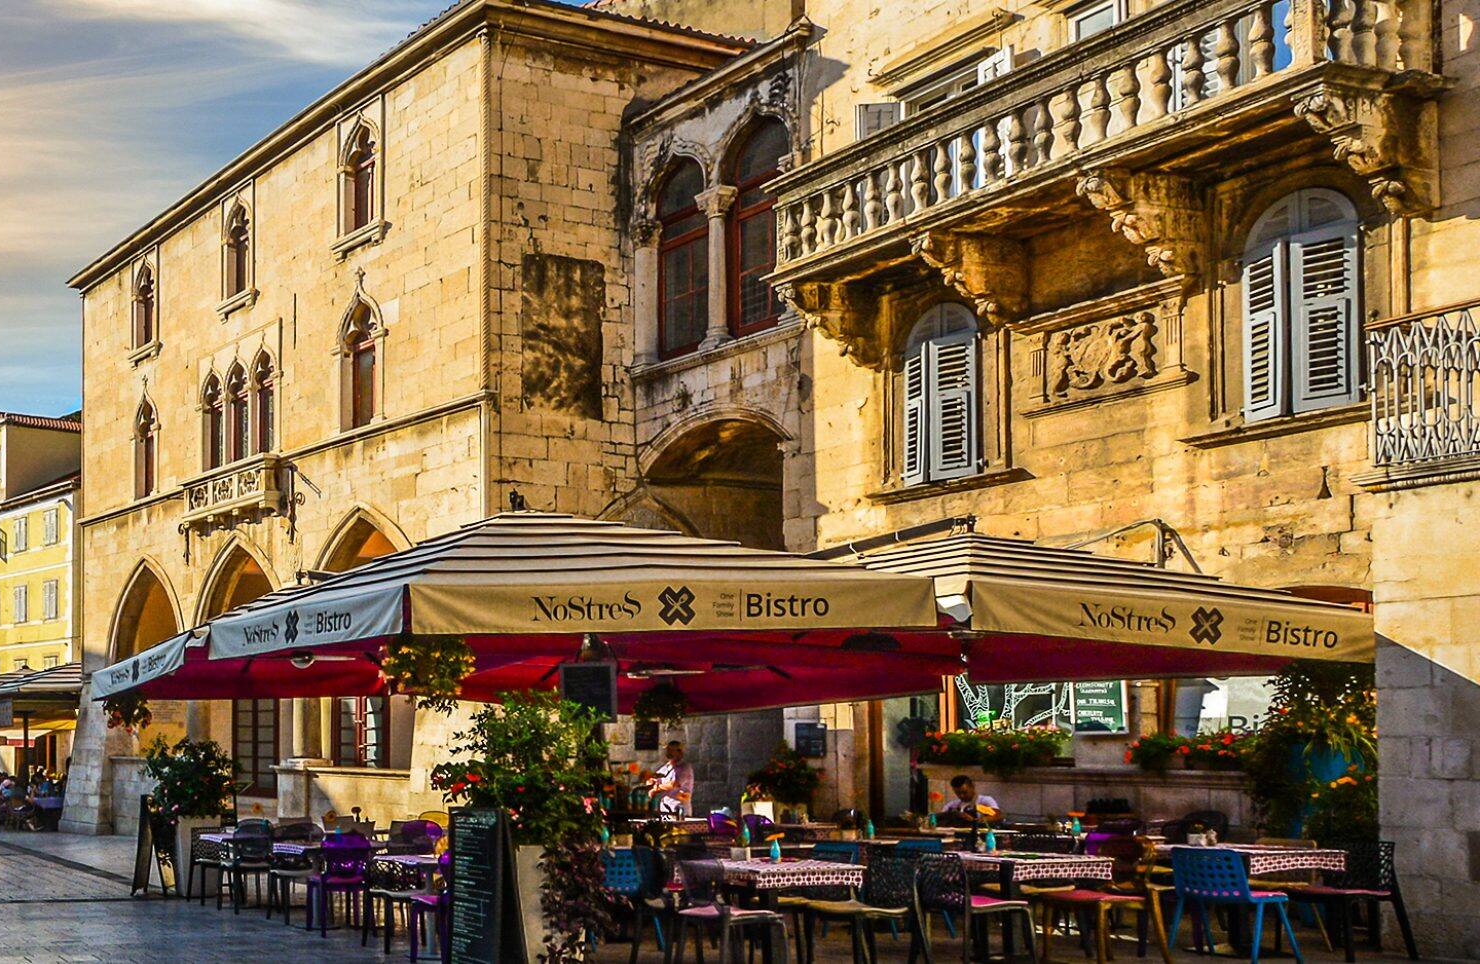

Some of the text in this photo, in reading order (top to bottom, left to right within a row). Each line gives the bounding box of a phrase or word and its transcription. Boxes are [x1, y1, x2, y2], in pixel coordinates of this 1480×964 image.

[746, 592, 829, 617] Bistro
[316, 611, 352, 634] Bistro
[1266, 621, 1338, 648] Bistro
